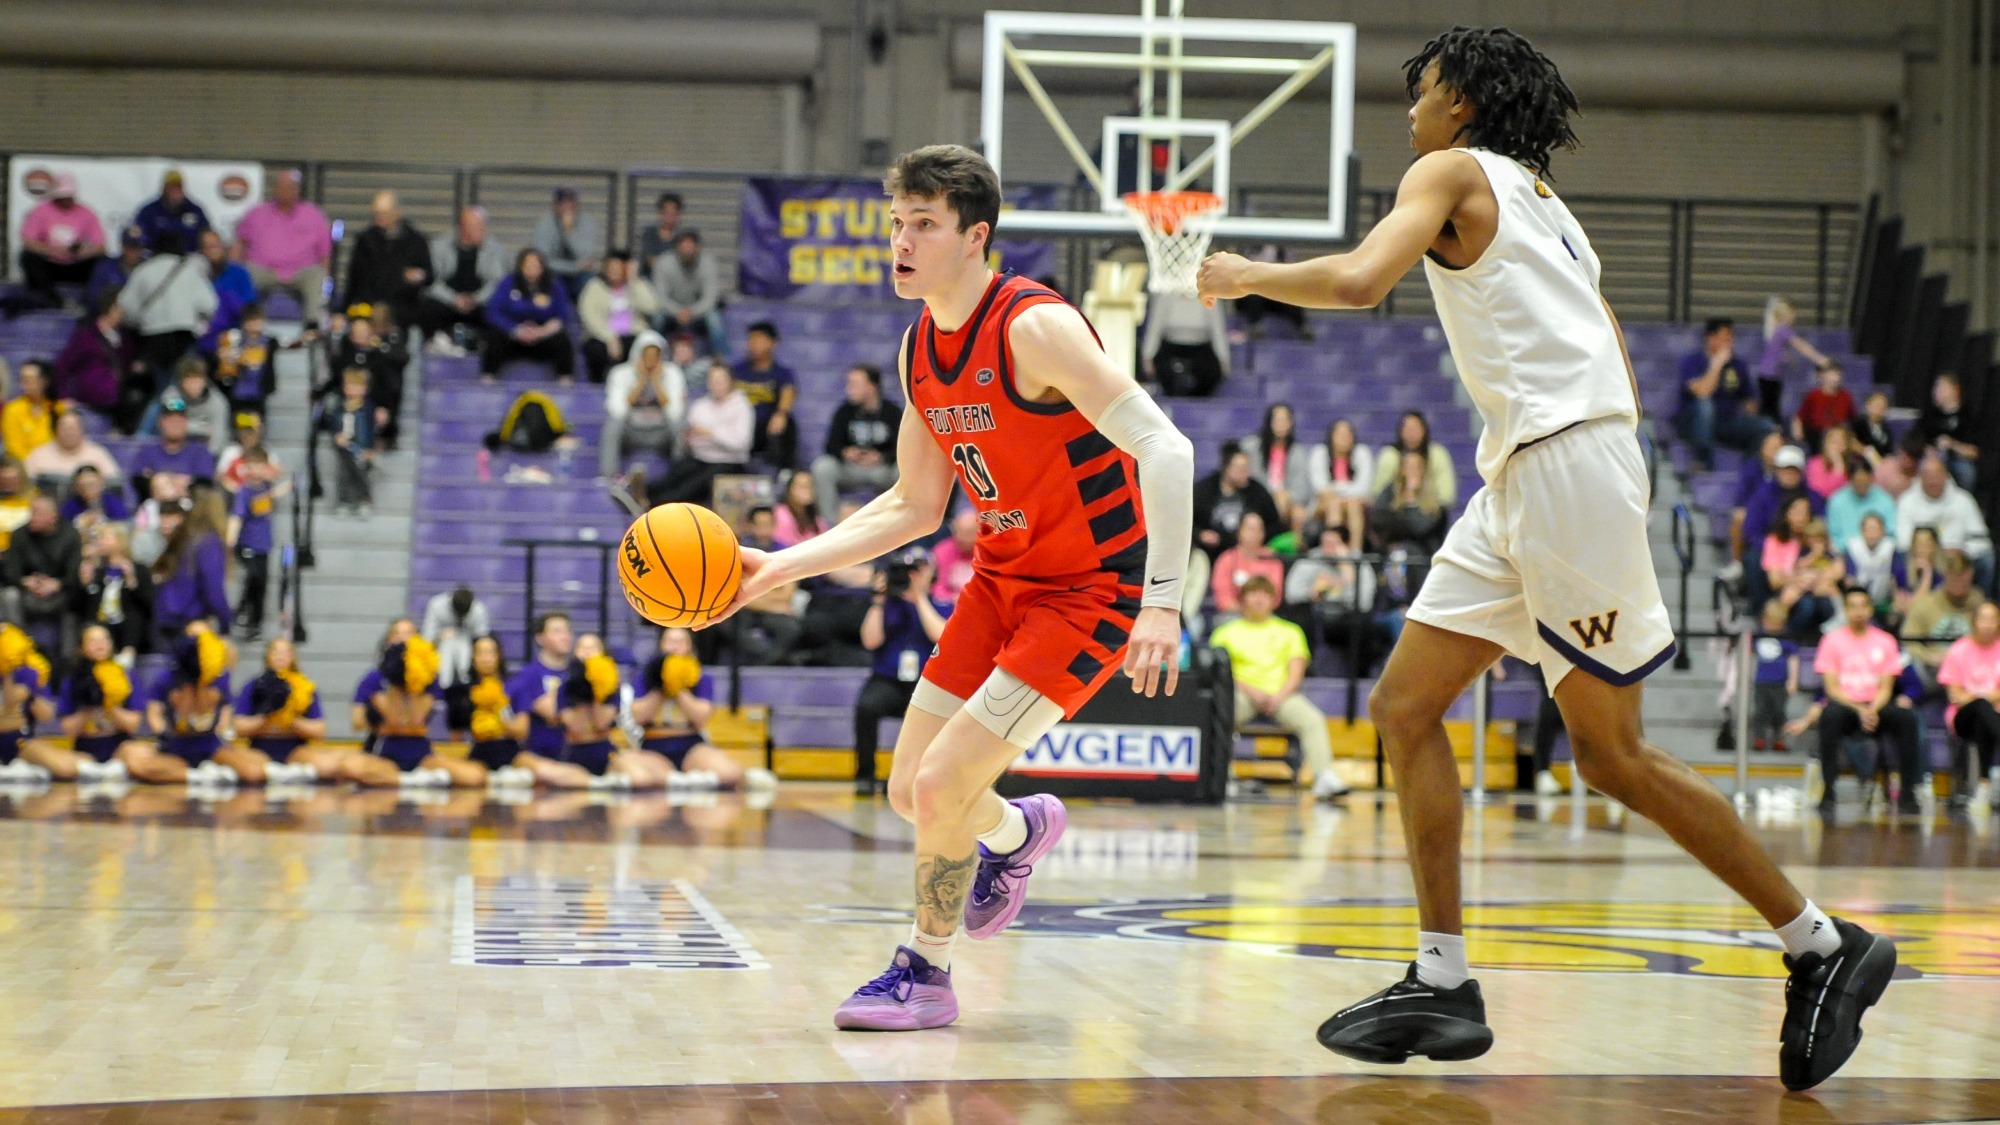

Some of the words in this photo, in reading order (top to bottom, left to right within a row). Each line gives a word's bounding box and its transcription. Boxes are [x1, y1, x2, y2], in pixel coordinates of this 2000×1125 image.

[925, 403, 996, 434] SOUTERN
[952, 443, 999, 500] 10
[625, 528, 651, 579] NCAA
[1568, 609, 1618, 650] W
[1025, 731, 1194, 768] WGEM
